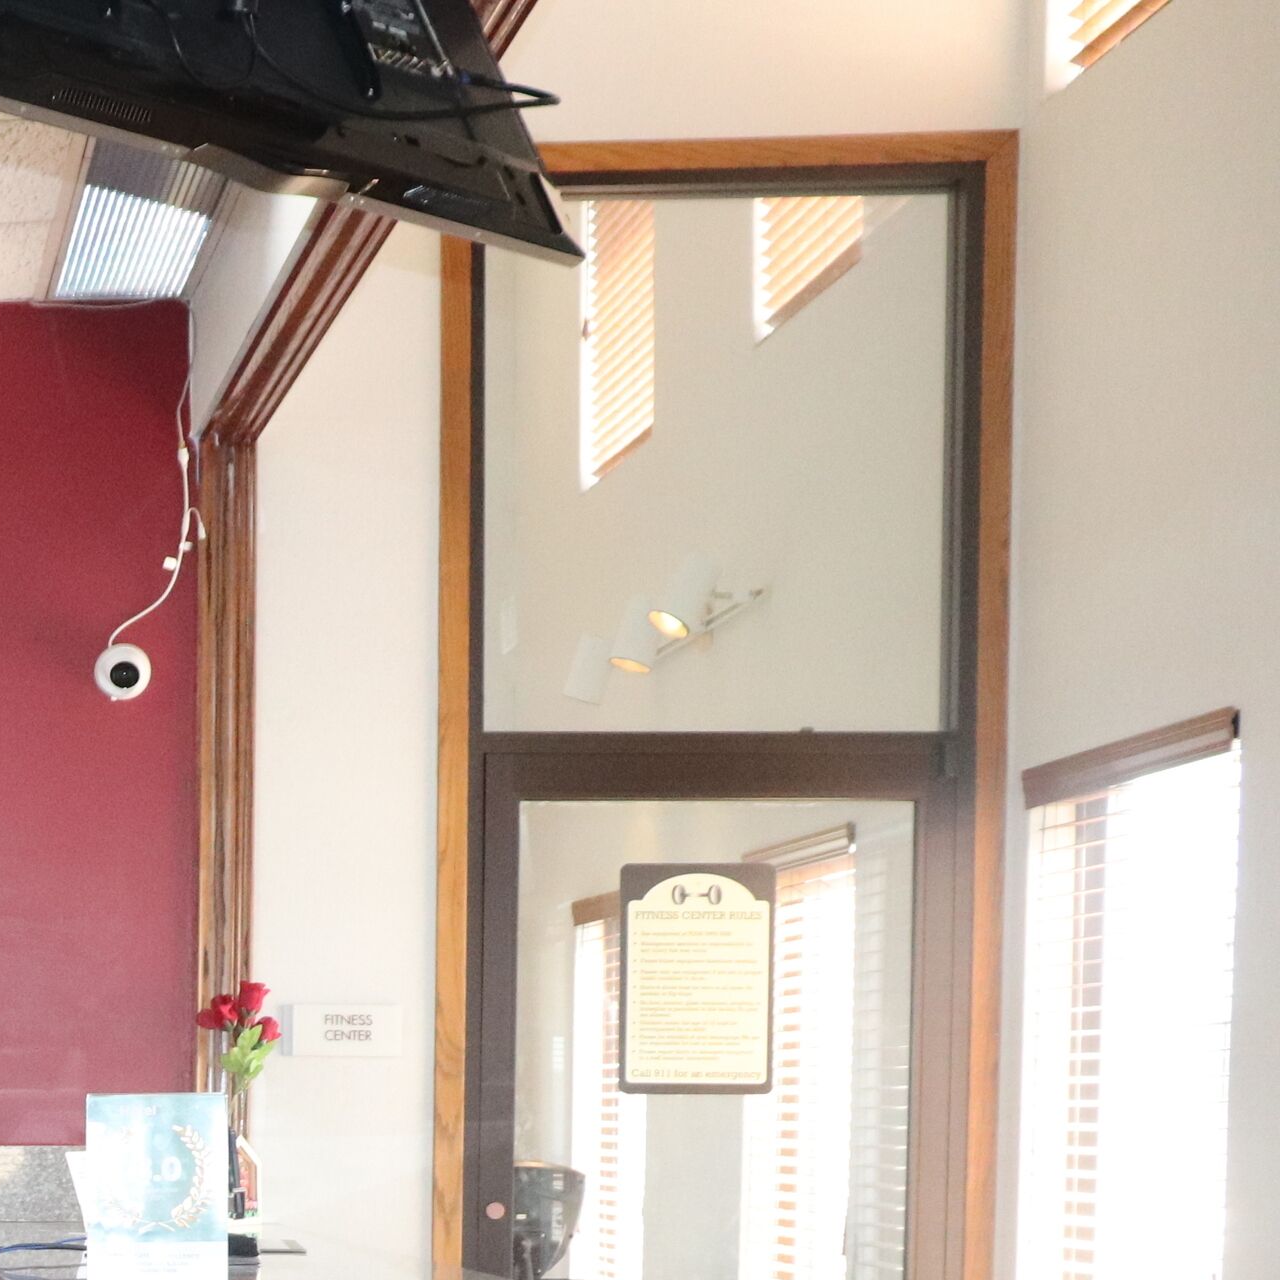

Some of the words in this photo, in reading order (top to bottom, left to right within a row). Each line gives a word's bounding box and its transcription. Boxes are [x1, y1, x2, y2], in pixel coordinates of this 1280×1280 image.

[635, 911, 680, 920] FITNESS
[681, 911, 726, 920] CENTER
[729, 911, 762, 920] RULES
[324, 1014, 373, 1026] FITNESS
[324, 1029, 373, 1041] CENTER
[631, 1068, 651, 1078] Call
[654, 1068, 670, 1078] 911
[674, 1068, 688, 1078] for
[705, 1071, 762, 1081] emergency
